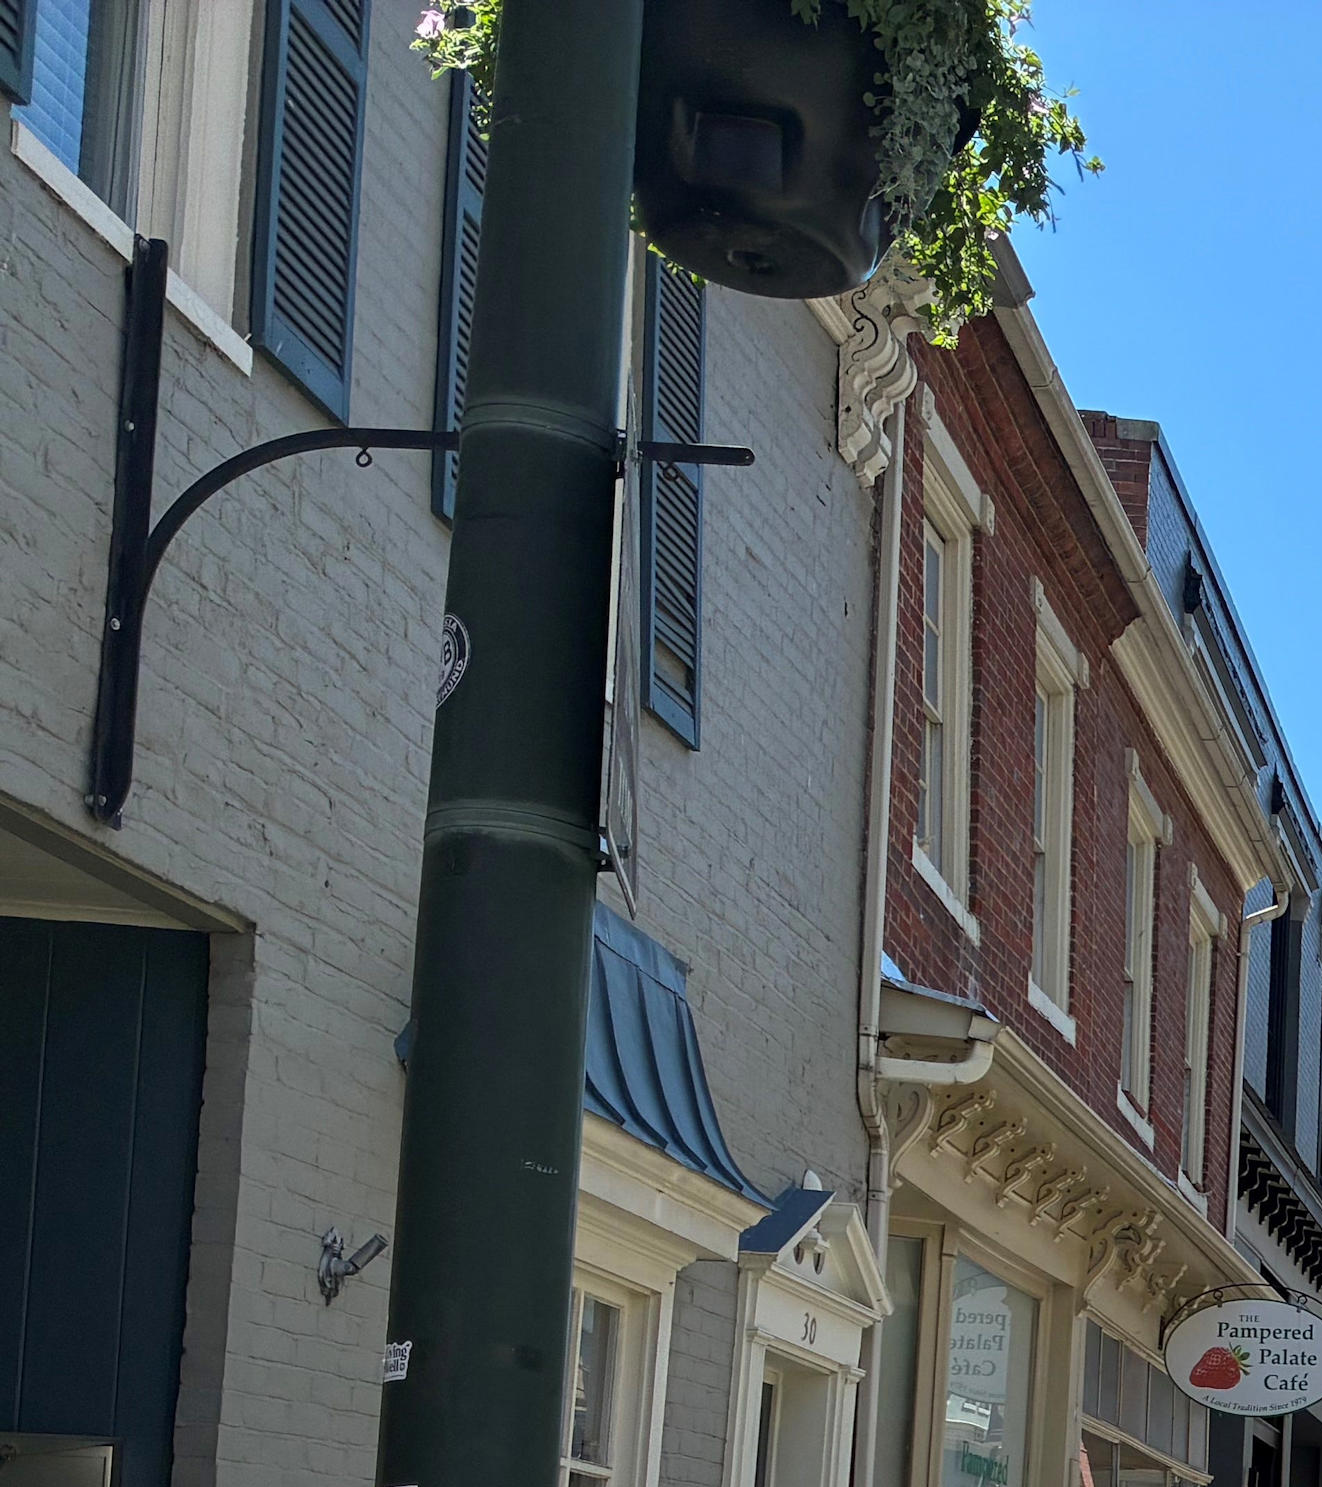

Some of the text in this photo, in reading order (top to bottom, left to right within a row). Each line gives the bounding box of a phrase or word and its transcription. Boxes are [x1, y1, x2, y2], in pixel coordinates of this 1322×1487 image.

[800, 1312, 817, 1345] 30
[1217, 1322, 1313, 1344] Pampered
[1259, 1349, 1317, 1366] Palate
[1264, 1373, 1308, 1391] Café
[1210, 1399, 1231, 1409] Local
[1233, 1402, 1268, 1412] Tradition
[1269, 1401, 1288, 1411] Since
